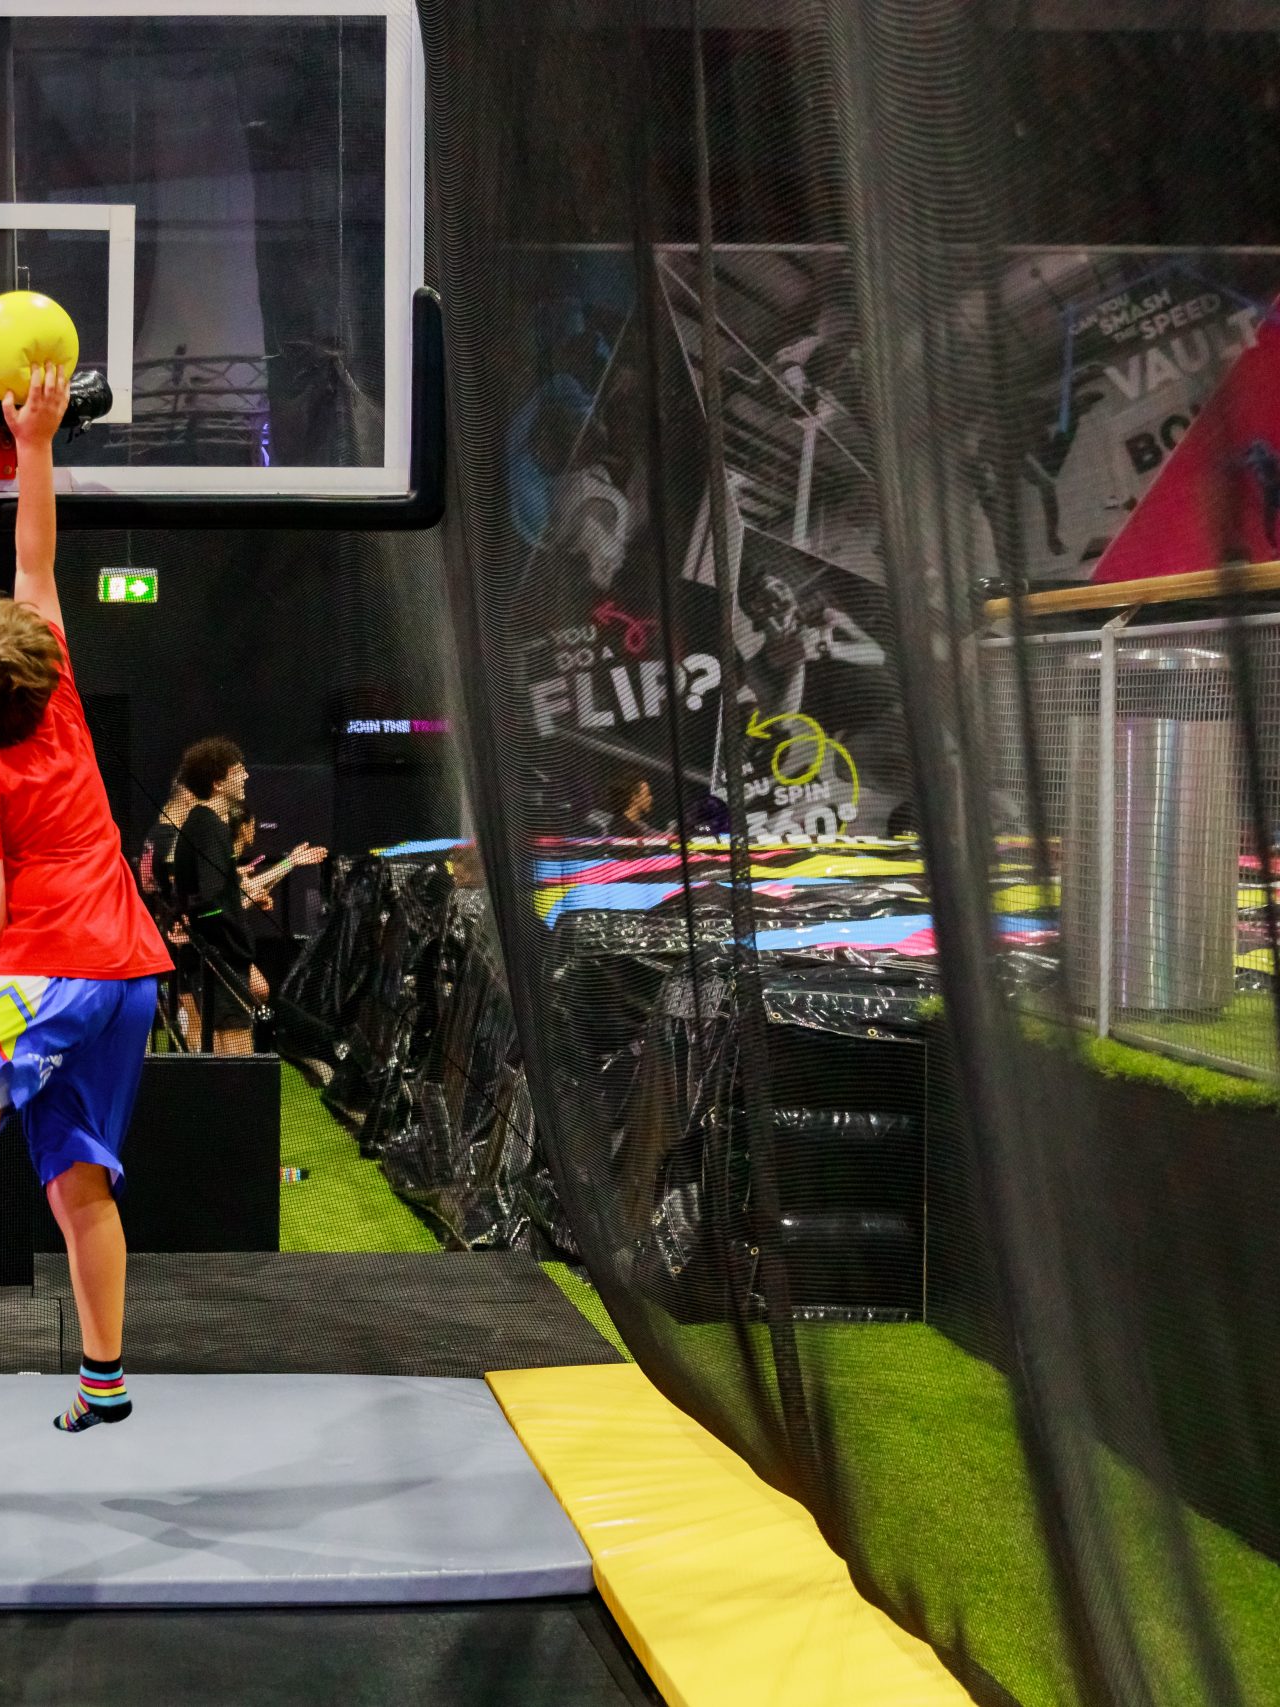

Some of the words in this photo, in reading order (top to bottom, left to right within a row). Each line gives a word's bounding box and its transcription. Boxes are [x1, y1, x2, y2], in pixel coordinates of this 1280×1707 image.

[1099, 289, 1172, 336] SMASH
[1139, 293, 1221, 340] SPEED
[1125, 404, 1200, 475] BO
[551, 624, 598, 646] YOU
[556, 648, 595, 672] DO
[528, 653, 722, 739] FLIP?
[347, 719, 381, 733] JOIN
[382, 719, 411, 733] THE
[773, 782, 831, 806] SPIN
